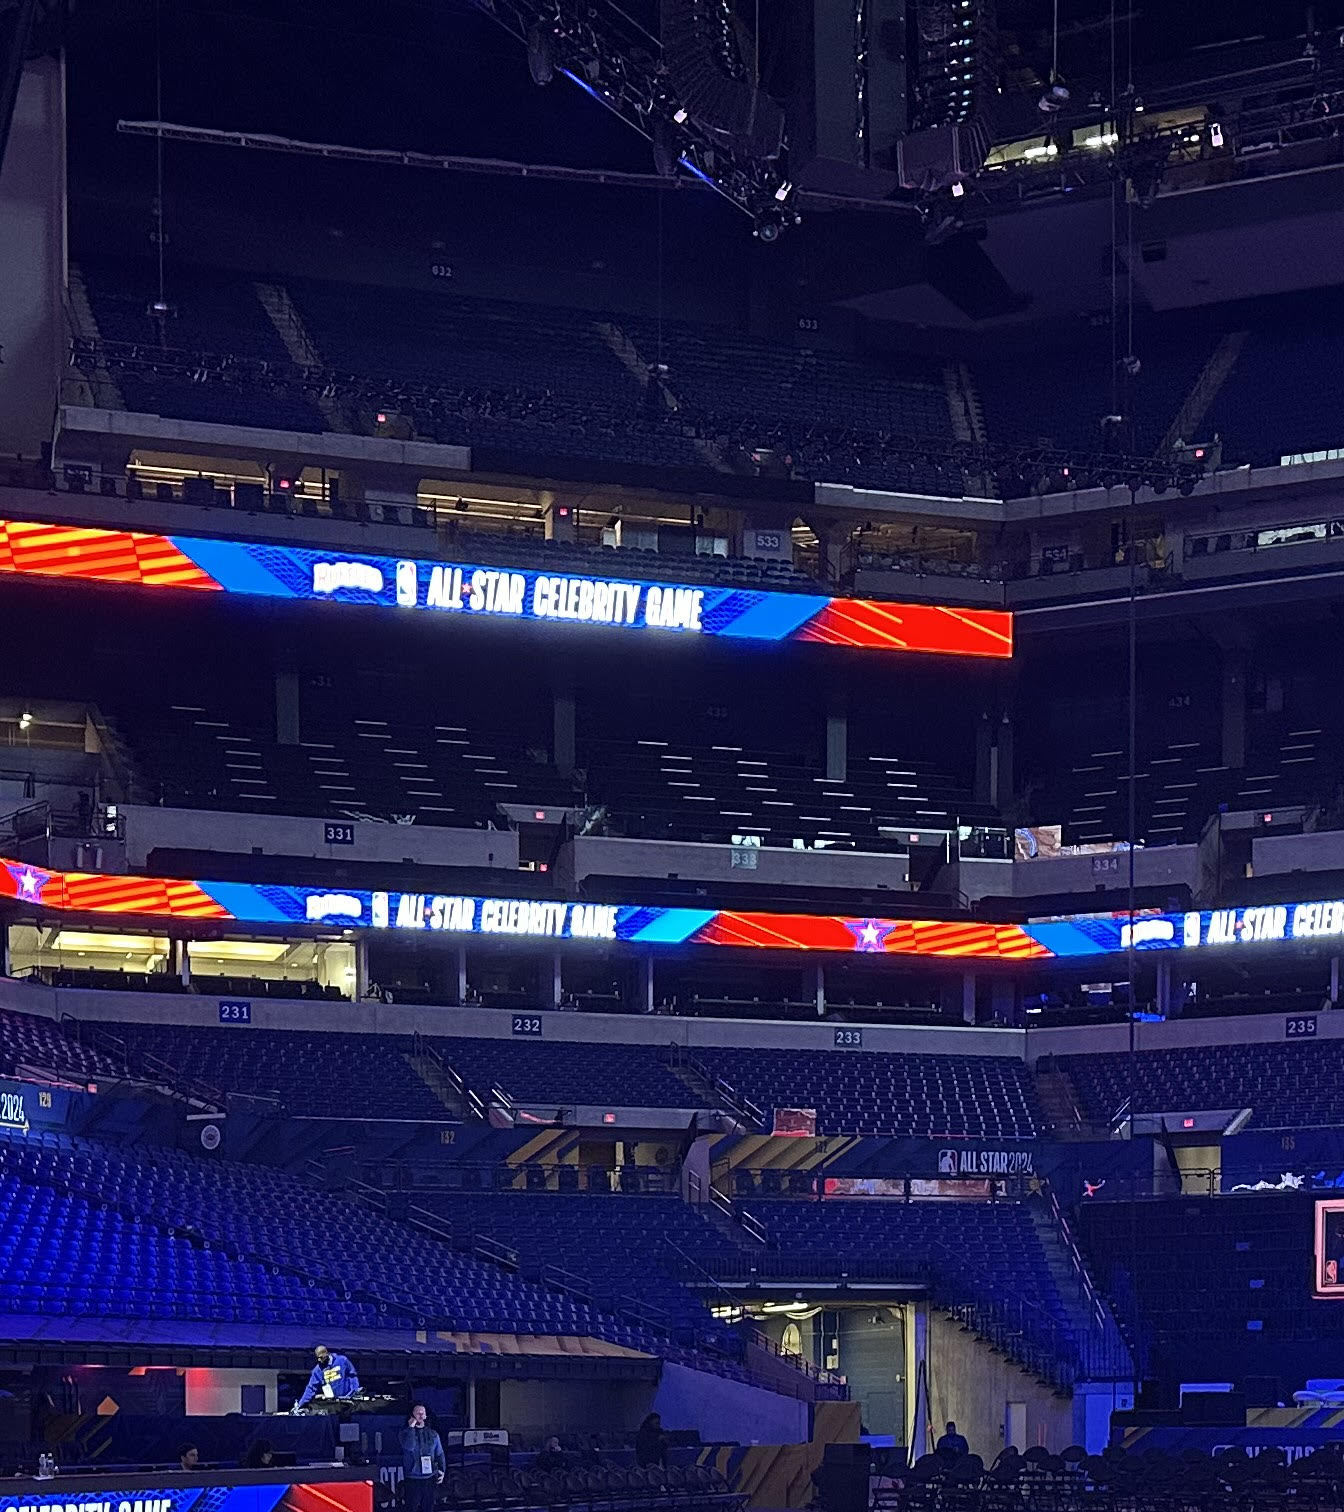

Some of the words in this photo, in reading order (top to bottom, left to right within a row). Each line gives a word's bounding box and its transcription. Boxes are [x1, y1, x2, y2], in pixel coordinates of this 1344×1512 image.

[431, 264, 454, 278] 632
[797, 317, 818, 330] 633
[756, 536, 779, 548] 533
[532, 574, 641, 624] CELEBRITY
[645, 586, 704, 631] GAME
[326, 827, 353, 841] 331
[1093, 858, 1118, 871] 334
[221, 1005, 249, 1019] 231
[513, 1018, 541, 1032] 232
[1287, 1019, 1315, 1034] 235
[836, 1031, 862, 1045] 233
[0, 1092, 26, 1123] 2024
[1008, 1152, 1034, 1174] 2024
